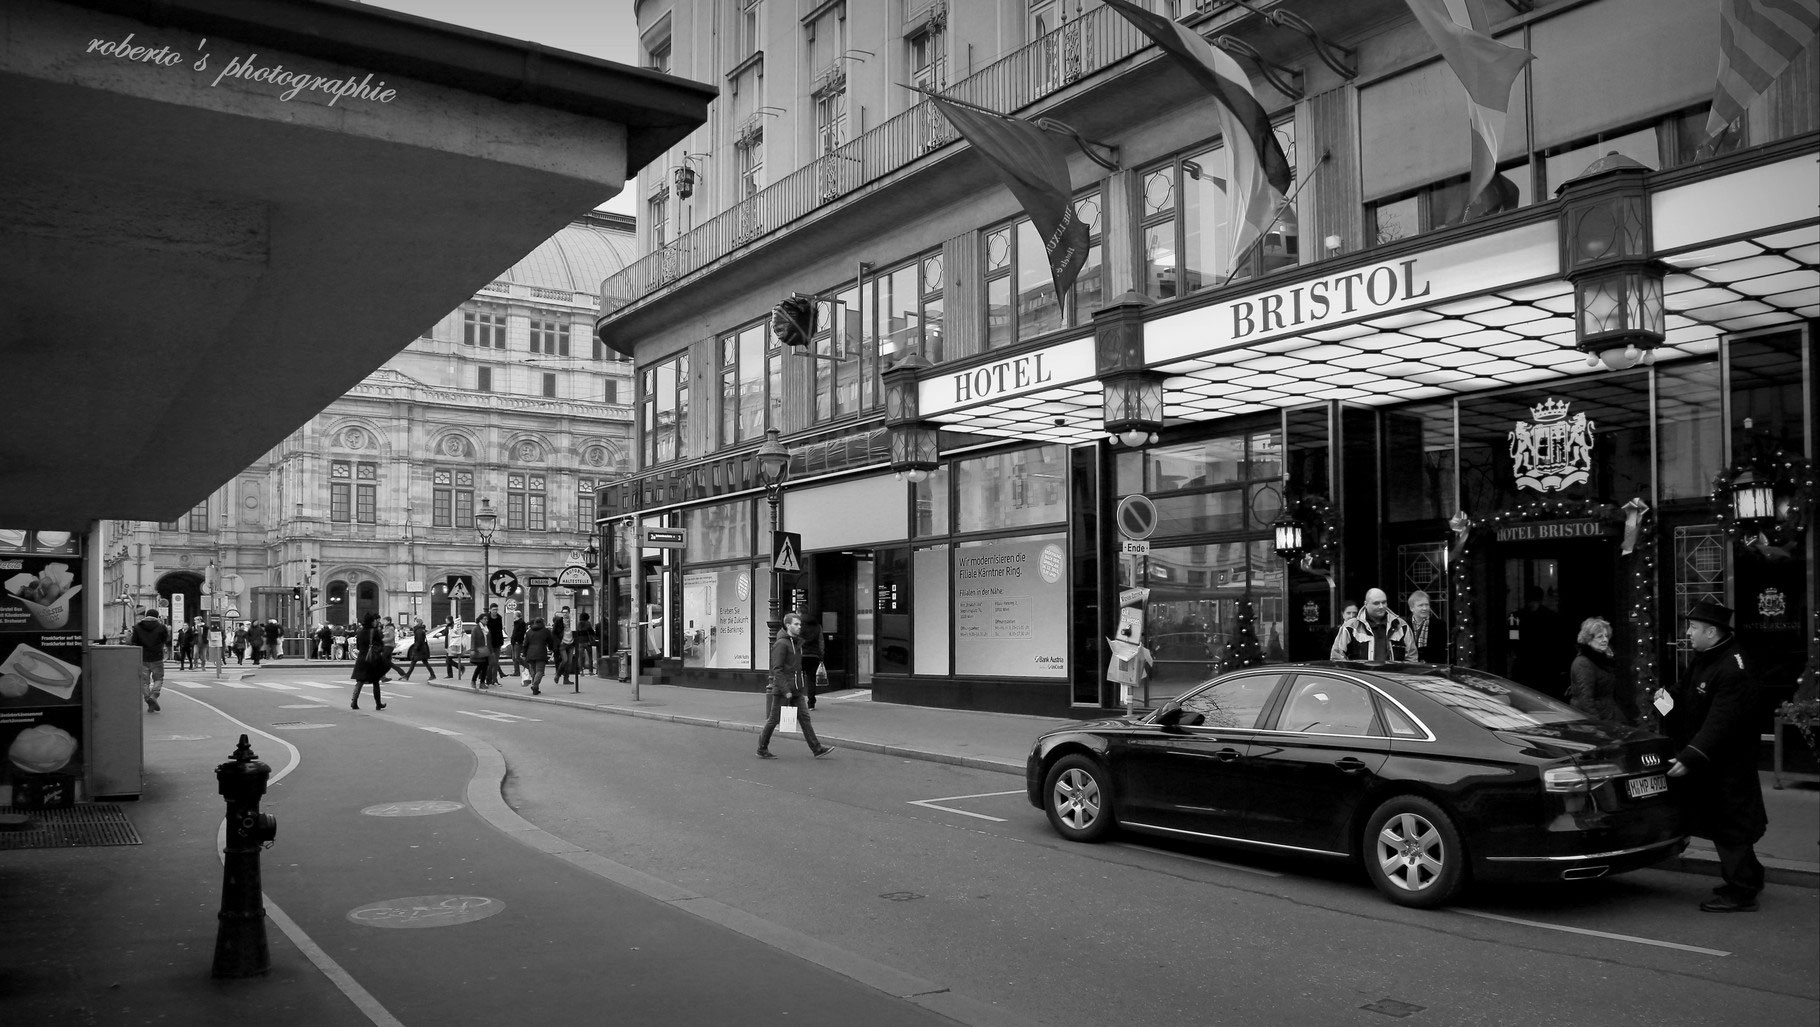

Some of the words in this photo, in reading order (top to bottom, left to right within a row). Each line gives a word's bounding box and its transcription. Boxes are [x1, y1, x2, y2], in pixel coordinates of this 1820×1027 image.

[954, 352, 1052, 403] HOTEL
[1230, 258, 1432, 340] BRISTOL
[1496, 526, 1535, 542] HOTEL
[1538, 522, 1604, 538] BRISTOL
[1127, 543, 1145, 553] Ende
[959, 557, 969, 568] Wir
[970, 554, 1015, 567] modernisieren
[1016, 553, 1026, 563] die
[566, 568, 586, 577] AUTOBUS
[959, 568, 977, 579] Filiale
[978, 567, 1006, 579] Kärntner
[1006, 566, 1023, 578] Ring.
